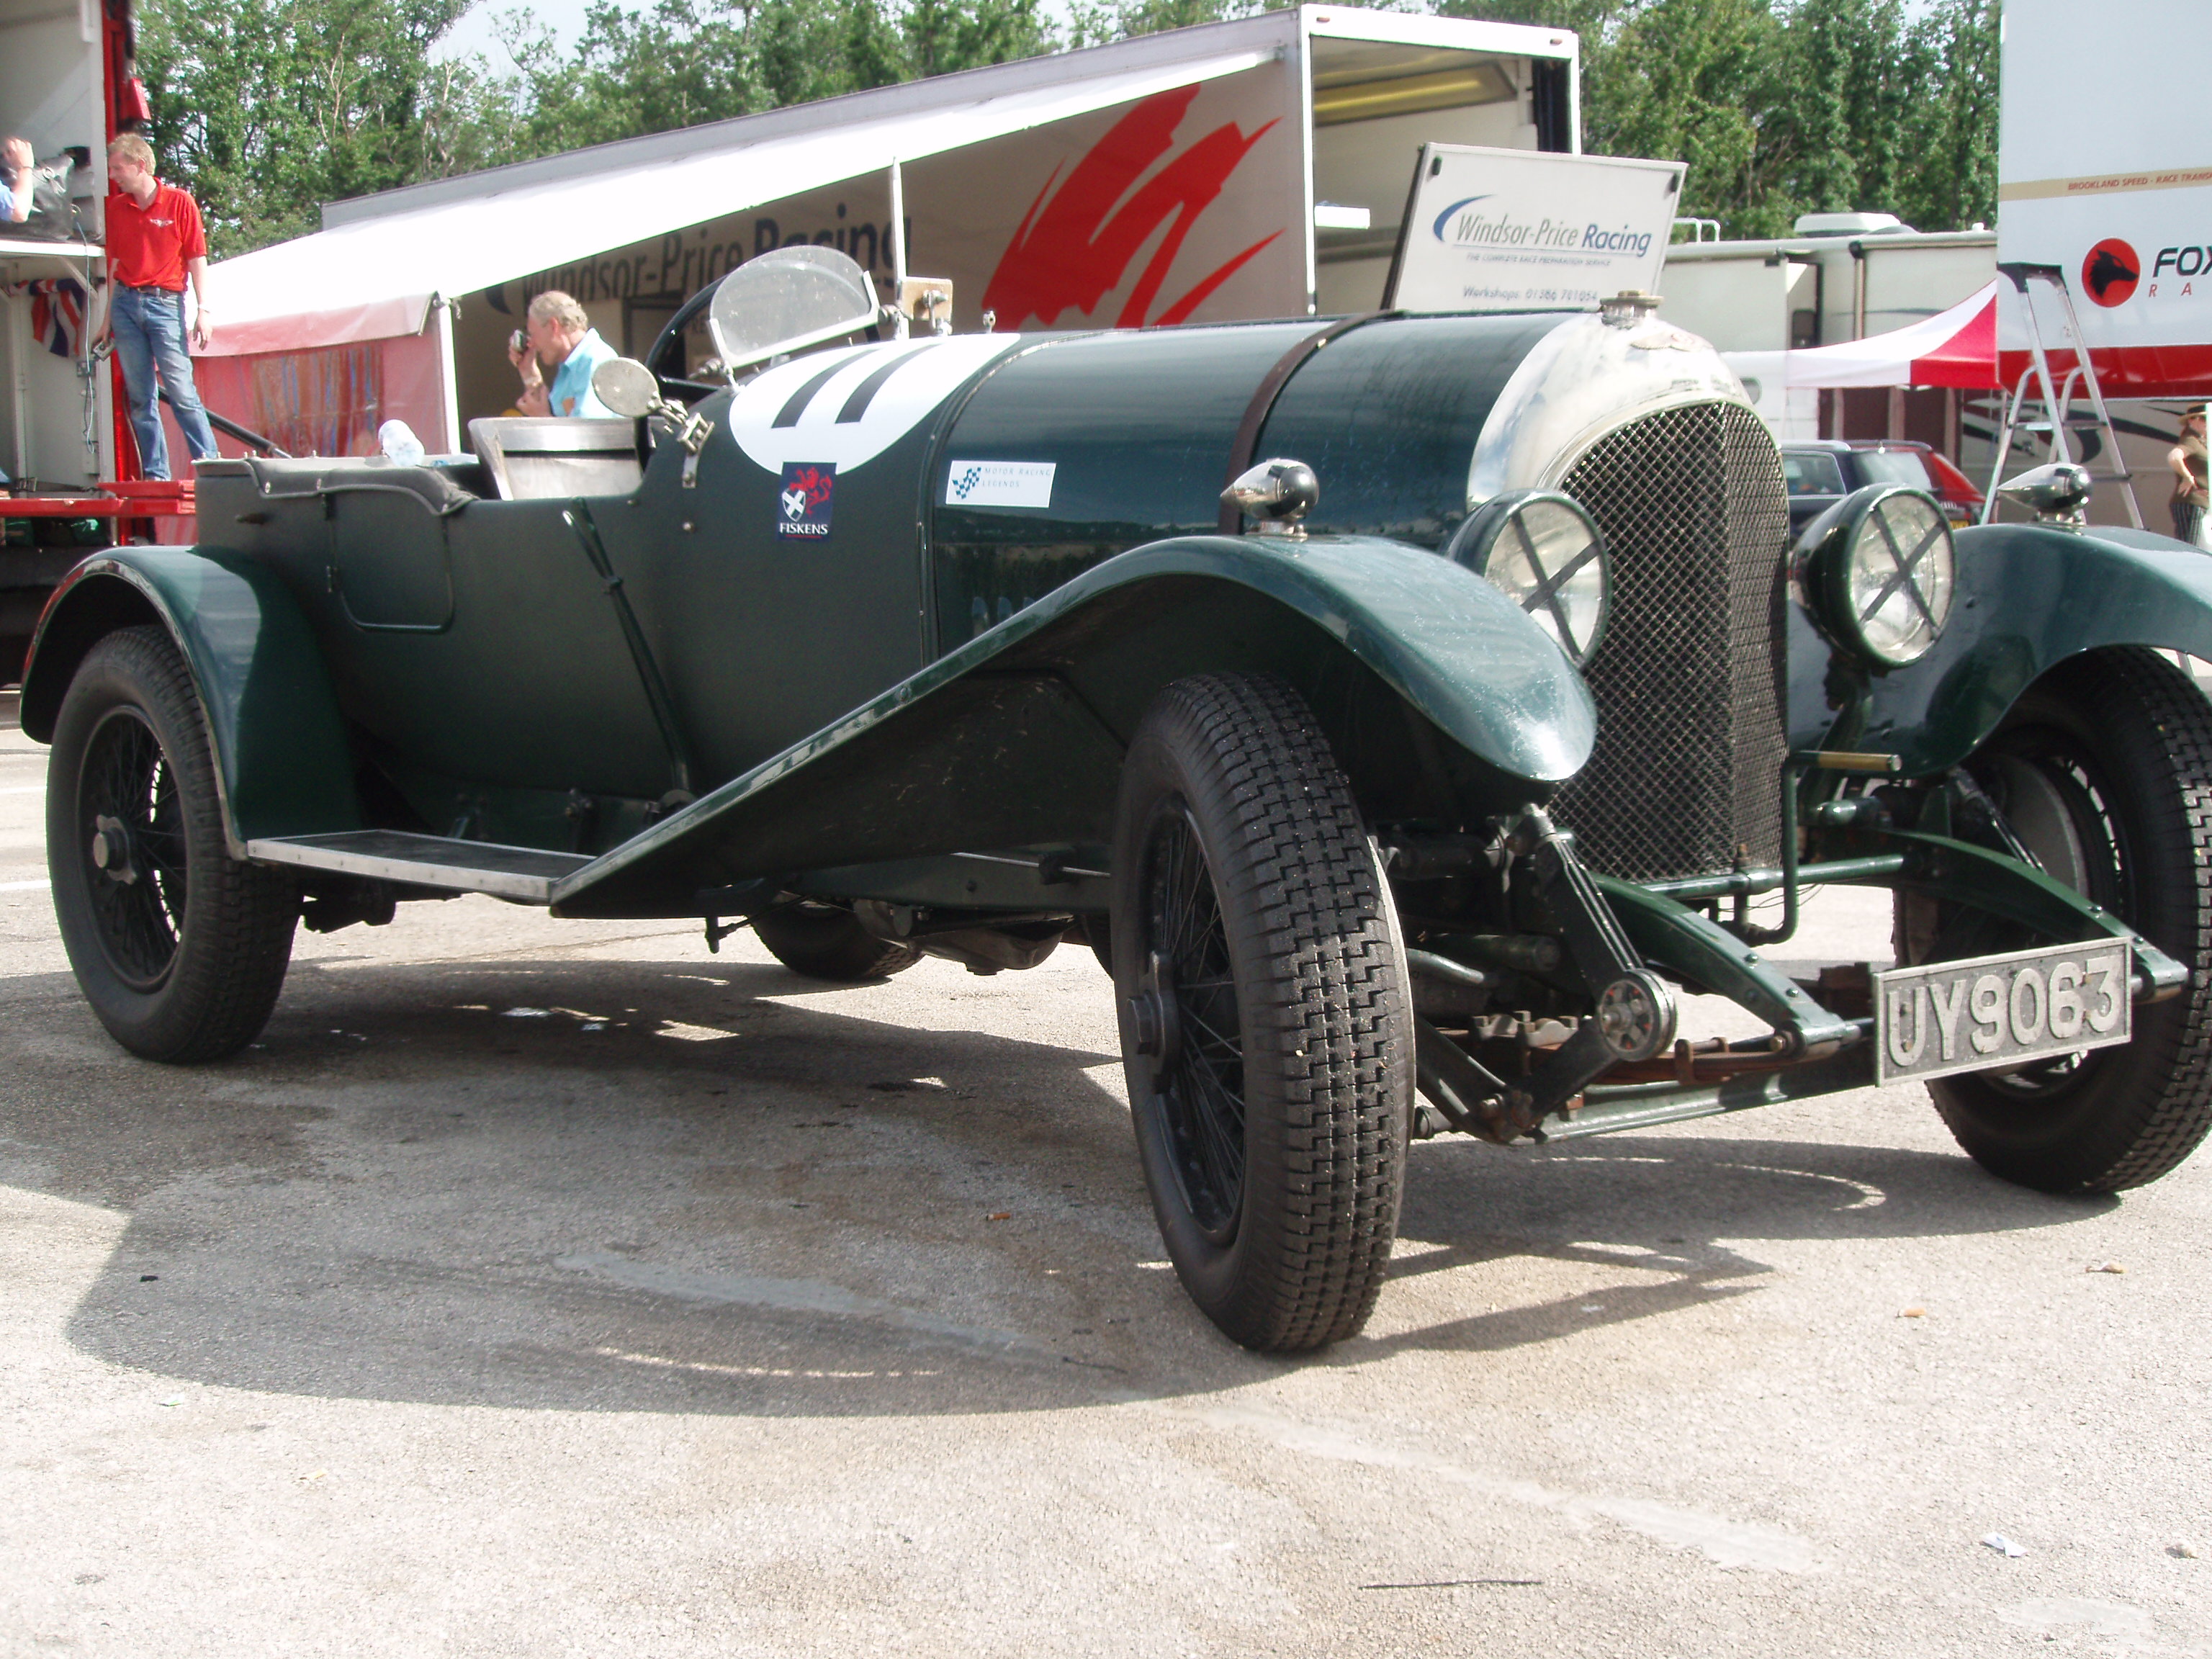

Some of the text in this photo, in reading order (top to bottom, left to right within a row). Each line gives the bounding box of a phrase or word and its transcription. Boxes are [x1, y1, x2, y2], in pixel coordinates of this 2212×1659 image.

[2068, 179, 2119, 191] BROOKLAND
[2122, 176, 2149, 187] SPEED
[2156, 174, 2178, 184] RACE
[756, 202, 912, 288] Ring
[1457, 212, 1653, 258] Windsor-Price Racing
[982, 480, 1020, 488] LEGENDS
[779, 522, 830, 535] FISKENS
[1887, 954, 2124, 1067] UY9063
